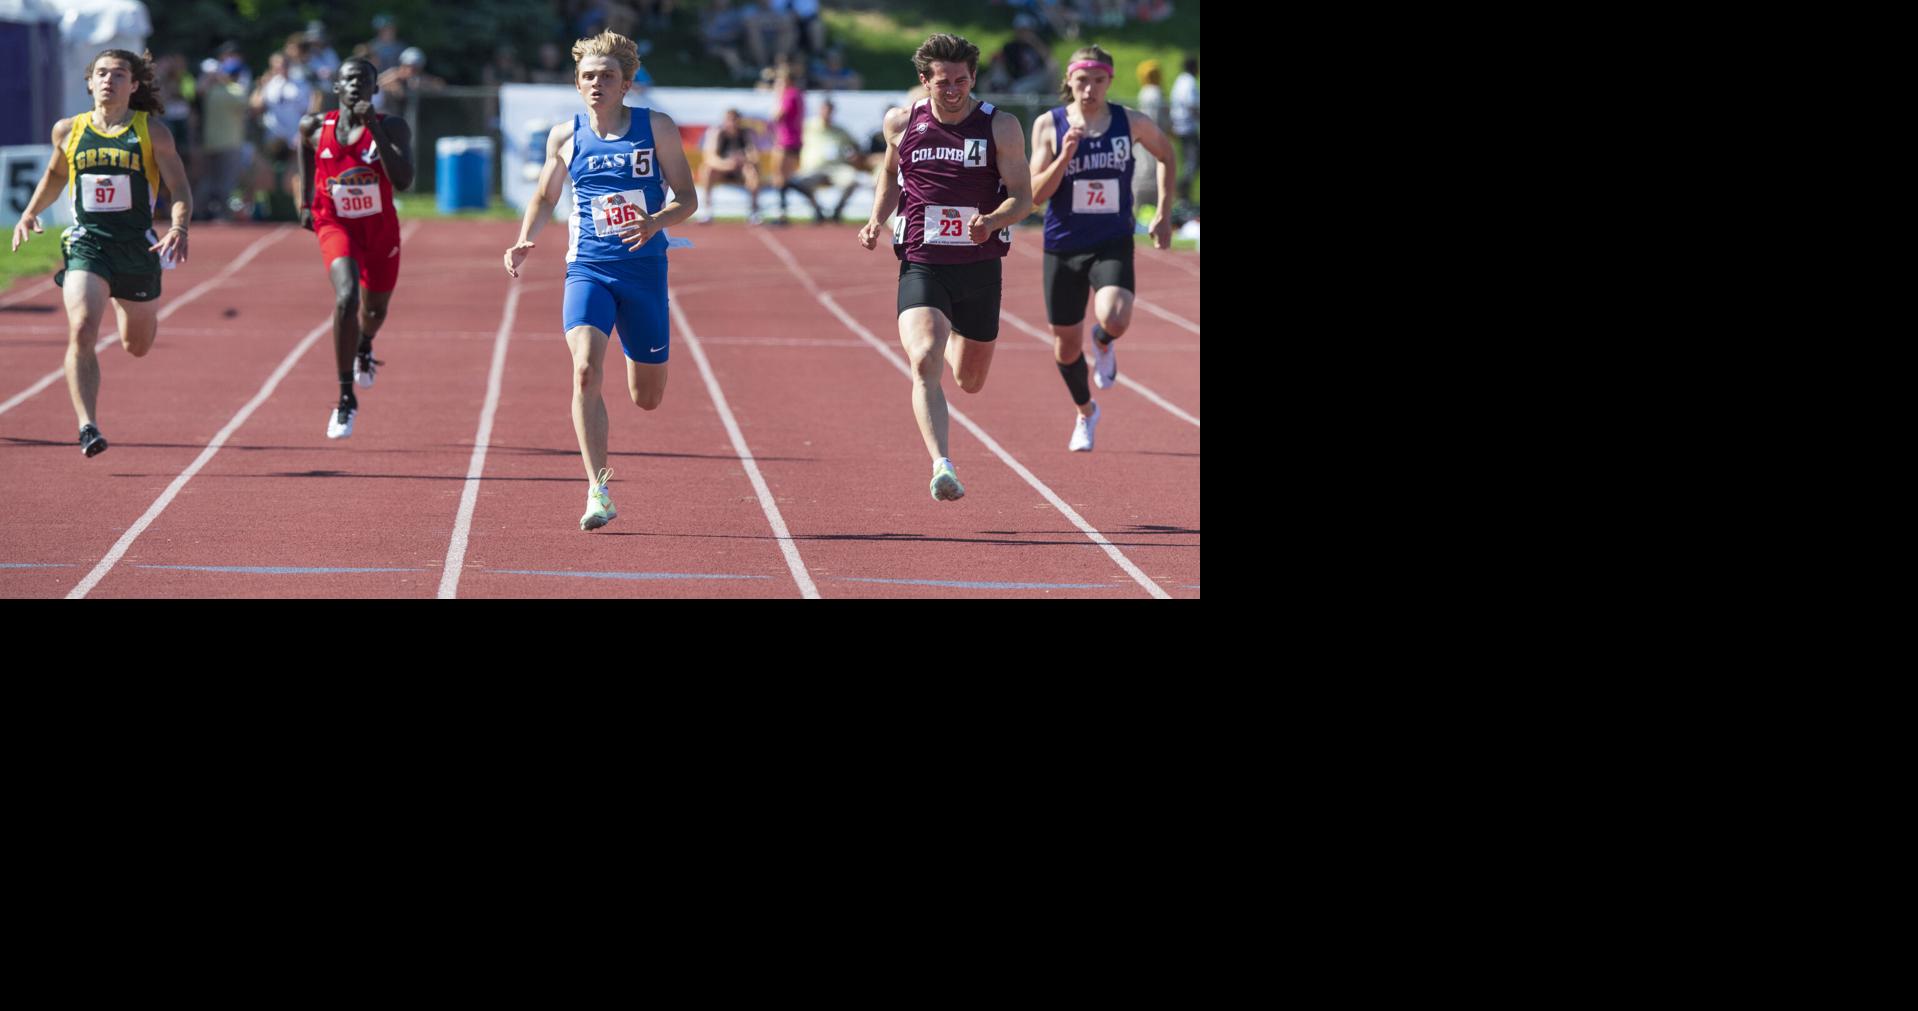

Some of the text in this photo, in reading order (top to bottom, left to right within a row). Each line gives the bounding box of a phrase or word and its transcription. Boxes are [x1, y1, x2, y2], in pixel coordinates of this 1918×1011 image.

[75, 147, 141, 172] GRETNA
[968, 141, 982, 166] 4
[1116, 138, 1126, 160] 3
[635, 150, 650, 176] 5
[10, 161, 36, 214] 5
[95, 187, 115, 203] 97
[1087, 191, 1105, 206] 74
[342, 196, 373, 211] 308
[604, 203, 636, 227] 136
[940, 219, 963, 237] 23
